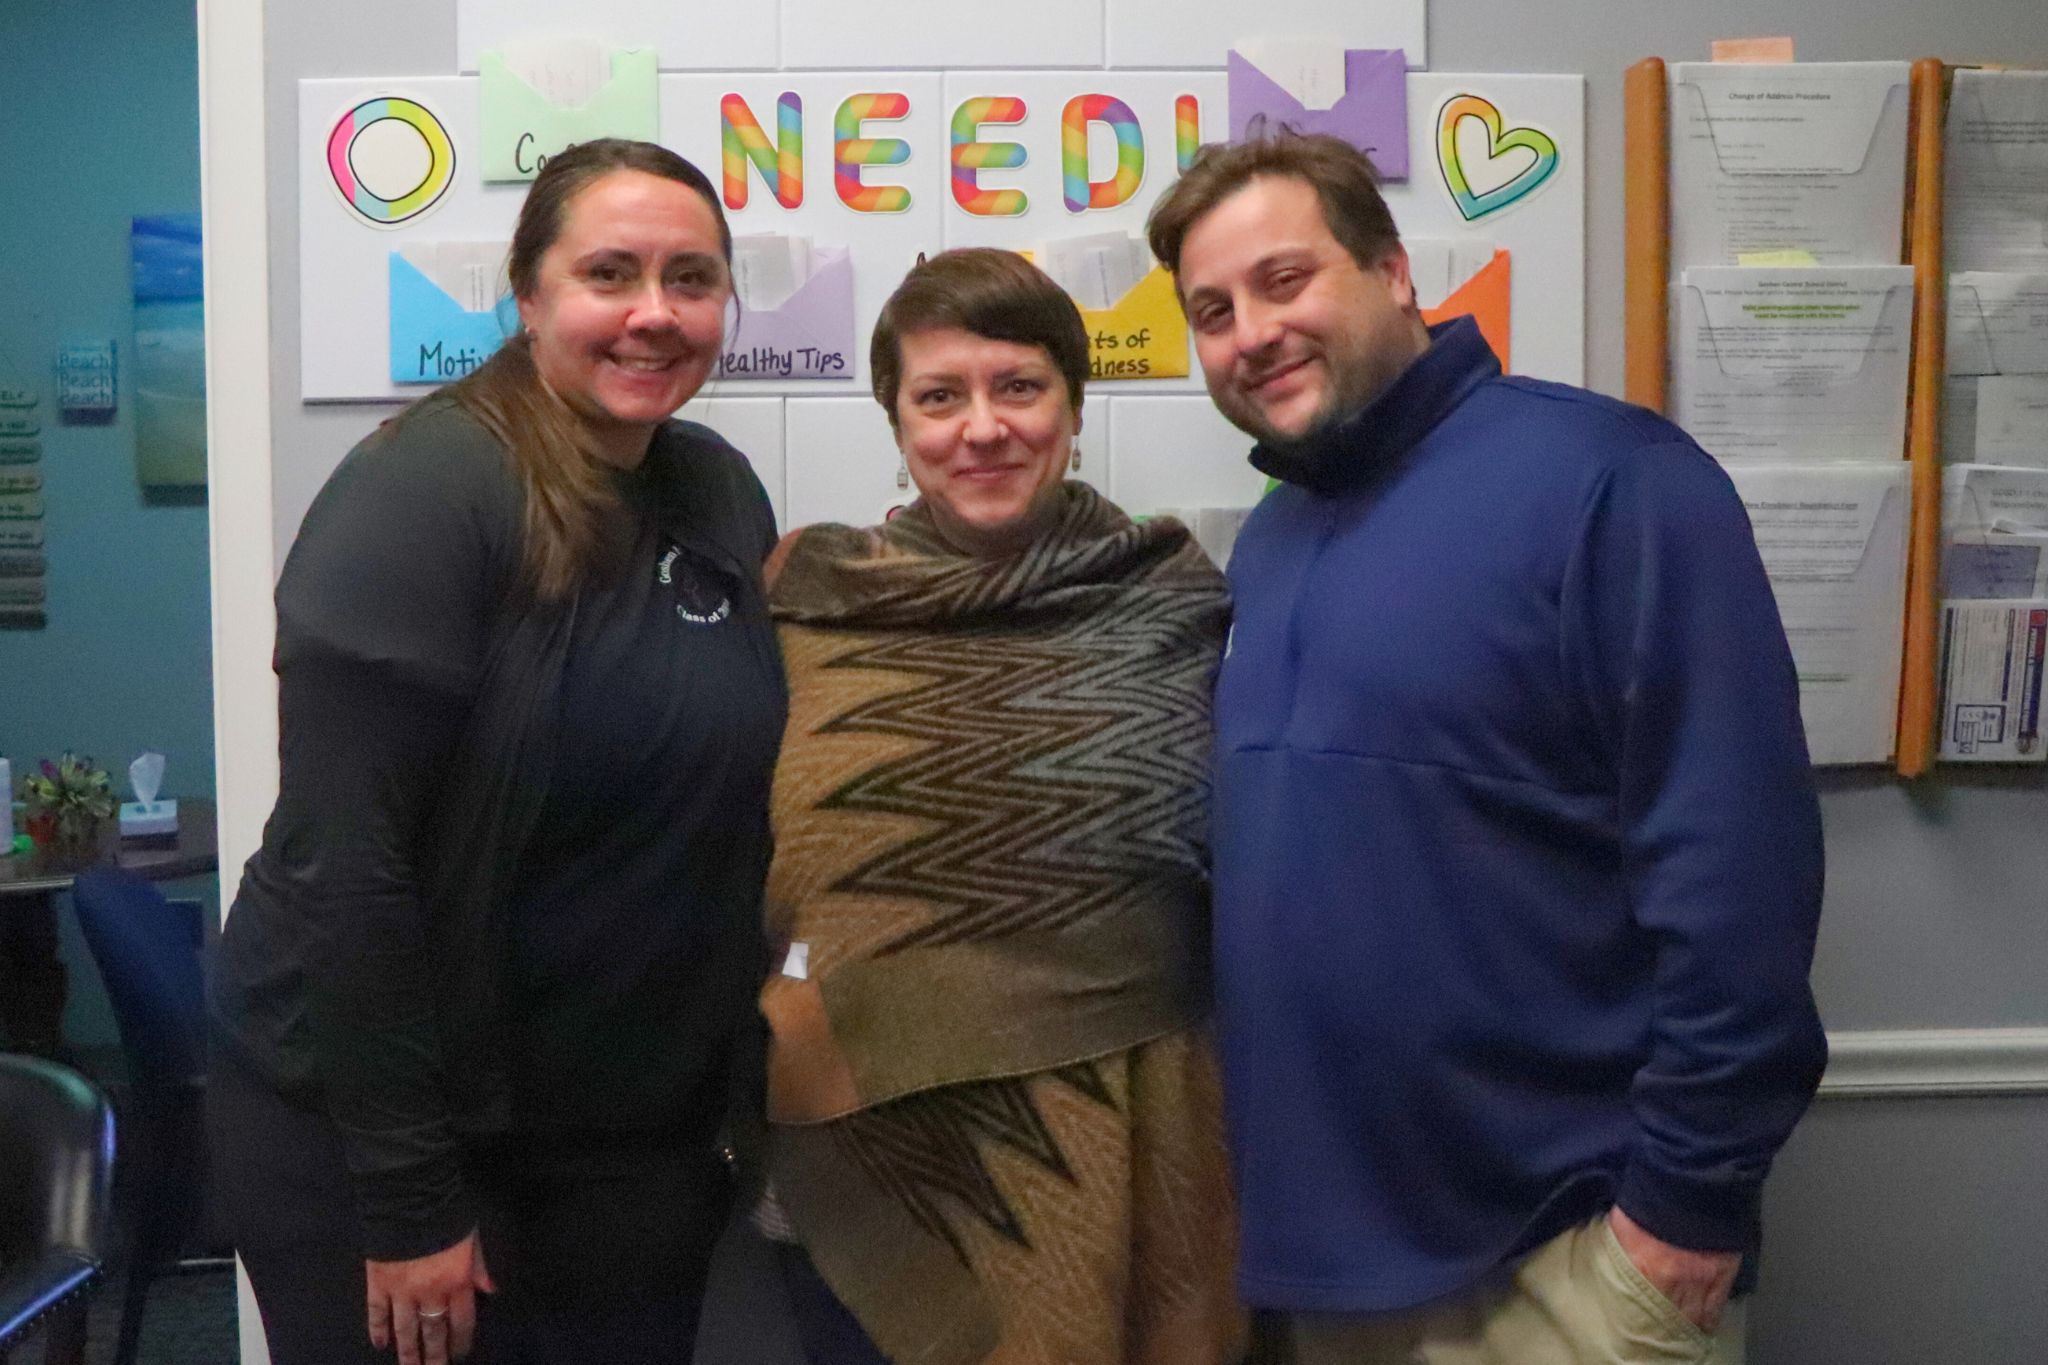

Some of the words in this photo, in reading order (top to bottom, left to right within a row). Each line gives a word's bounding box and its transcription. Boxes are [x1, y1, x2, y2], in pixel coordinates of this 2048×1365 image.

[1088, 330, 1119, 349] ts
[1126, 327, 1151, 348] of
[419, 340, 485, 377] Moti
[796, 346, 846, 374] Tips
